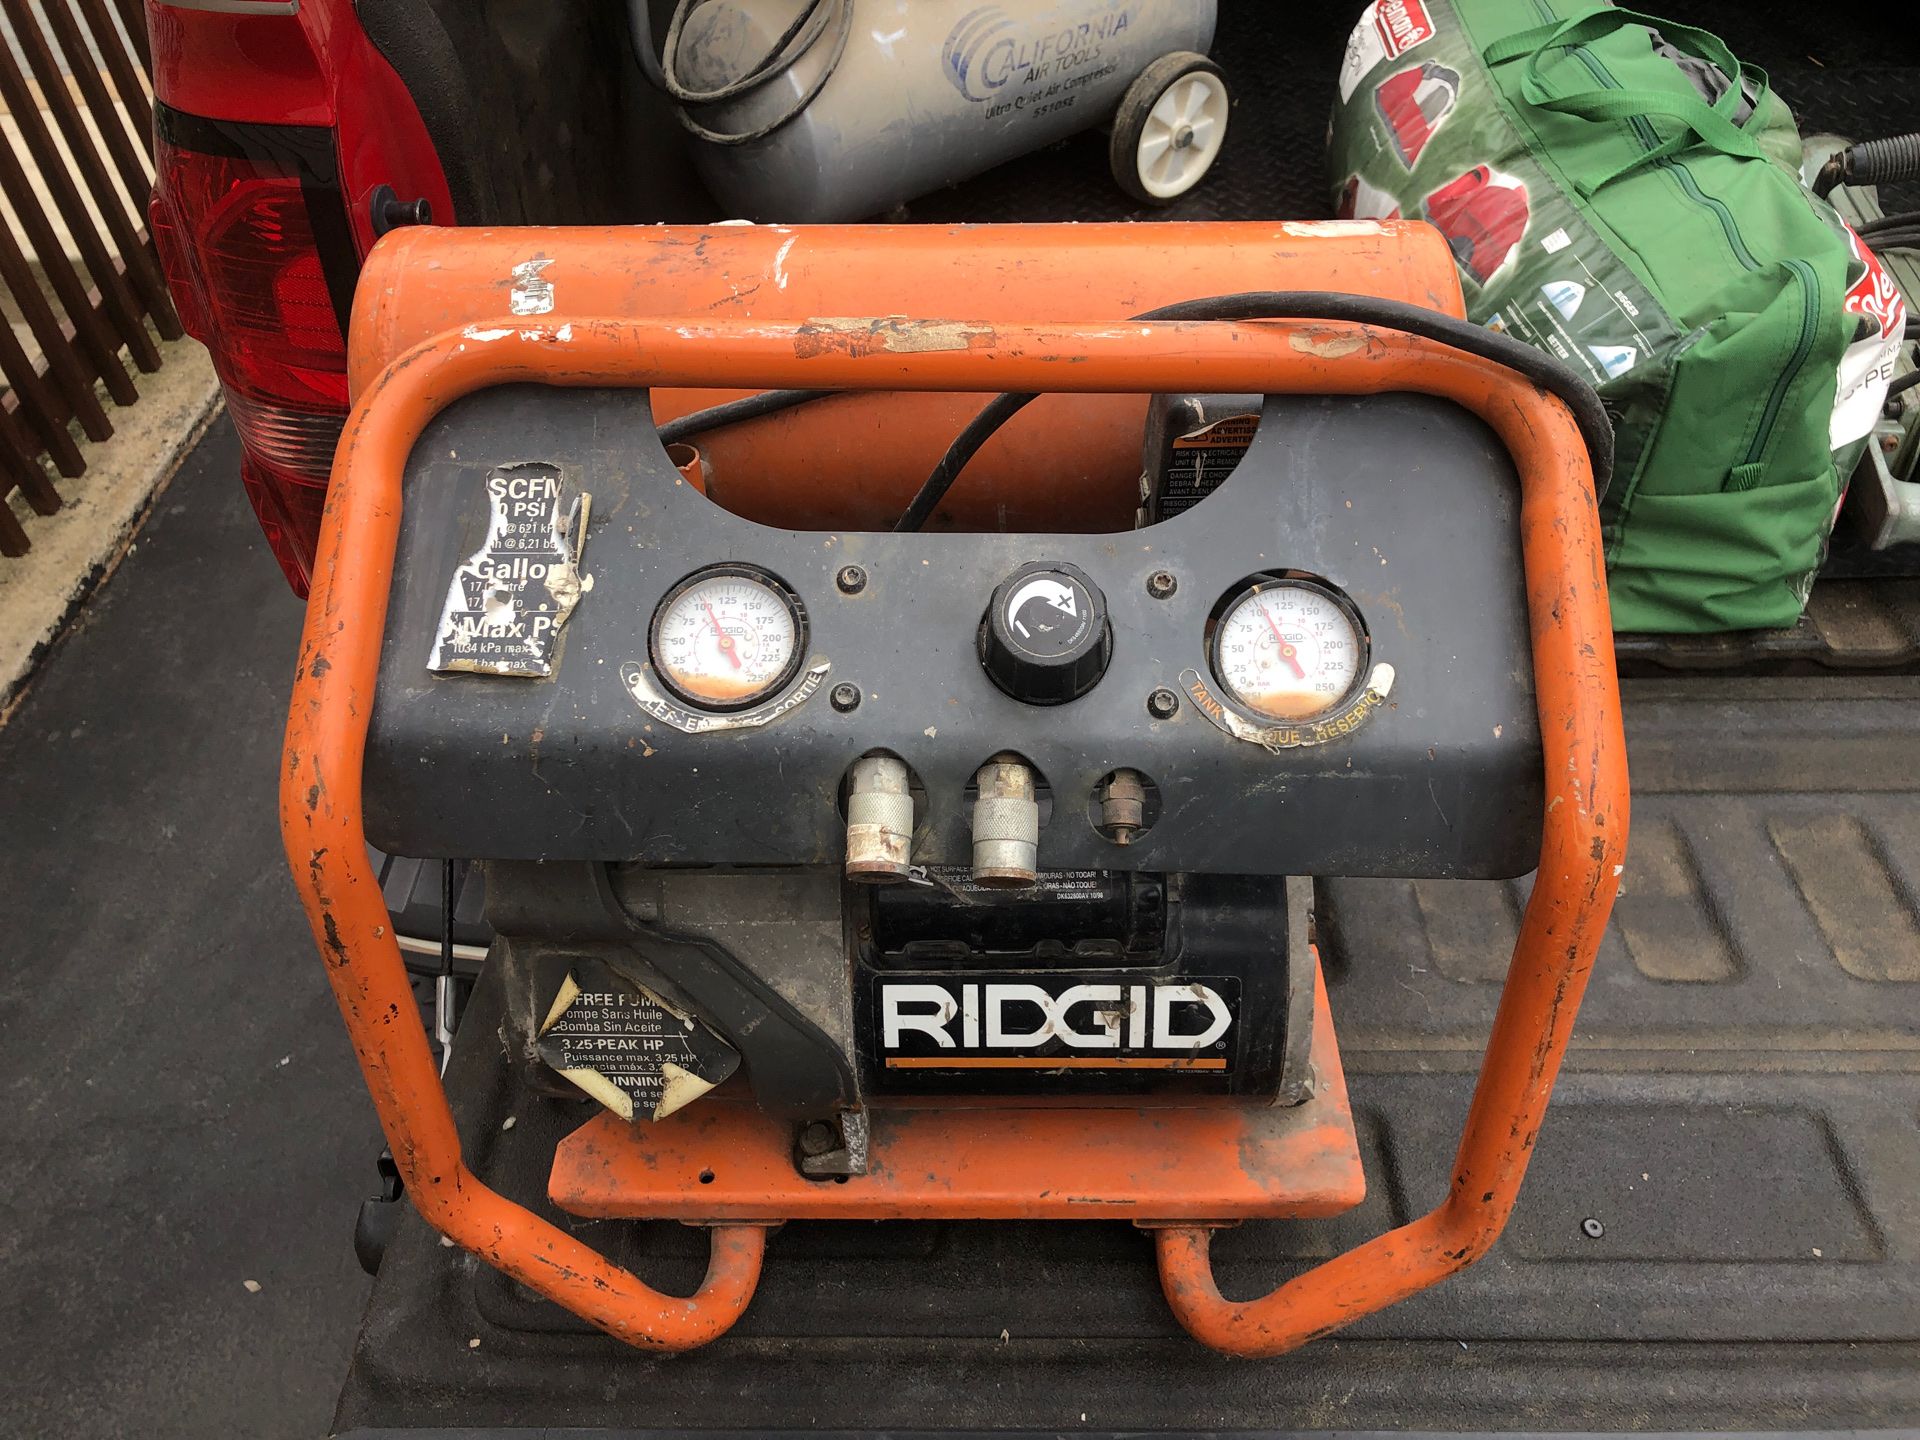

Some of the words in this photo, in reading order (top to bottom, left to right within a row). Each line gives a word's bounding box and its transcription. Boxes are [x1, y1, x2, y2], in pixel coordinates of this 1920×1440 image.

[982, 11, 1128, 89] CALIFORNIA
[1023, 65, 1049, 85] AIR
[1055, 46, 1101, 72] TOOLS
[985, 101, 1012, 119] Ultra
[1045, 82, 1061, 97] Air
[1063, 62, 1120, 91] Compressor
[514, 502, 546, 517] PSI
[540, 522, 554, 534] kP
[719, 596, 738, 605] 125
[694, 602, 713, 611] 100
[743, 602, 762, 610] 150
[1275, 602, 1294, 610] 125
[1250, 608, 1269, 617] 100
[1300, 607, 1320, 616] 150
[682, 617, 696, 626] 75
[755, 616, 775, 625] 175
[463, 616, 523, 638] Max
[710, 626, 744, 634] RDGID
[1240, 624, 1253, 633] 75
[1314, 622, 1334, 631] 175
[672, 637, 686, 645] 50
[762, 634, 782, 642] 200
[1269, 633, 1304, 641] RDGID
[480, 642, 502, 653] kPa
[1231, 644, 1245, 653] 50
[1323, 641, 1343, 649] 200
[673, 656, 686, 665] 25
[761, 654, 780, 662] 225
[1233, 664, 1247, 673] 25
[1324, 661, 1344, 670] 225
[1188, 680, 1224, 721] TANK
[575, 993, 614, 1007] FREE
[565, 1011, 599, 1021] ompe
[601, 1009, 630, 1020] Sans
[633, 1009, 663, 1020] Huile
[882, 983, 1233, 1049] RIDGID
[559, 1020, 601, 1031] Bomba
[603, 1022, 623, 1032] Sin
[624, 1022, 662, 1033] Aceite
[597, 1039, 639, 1050] PEAK
[643, 1039, 665, 1051] HP
[563, 1052, 623, 1063] Puissance
[626, 1054, 653, 1063] max.
[655, 1053, 678, 1064] 3,25
[680, 1053, 698, 1063] HP
[619, 1062, 647, 1071] máx.
